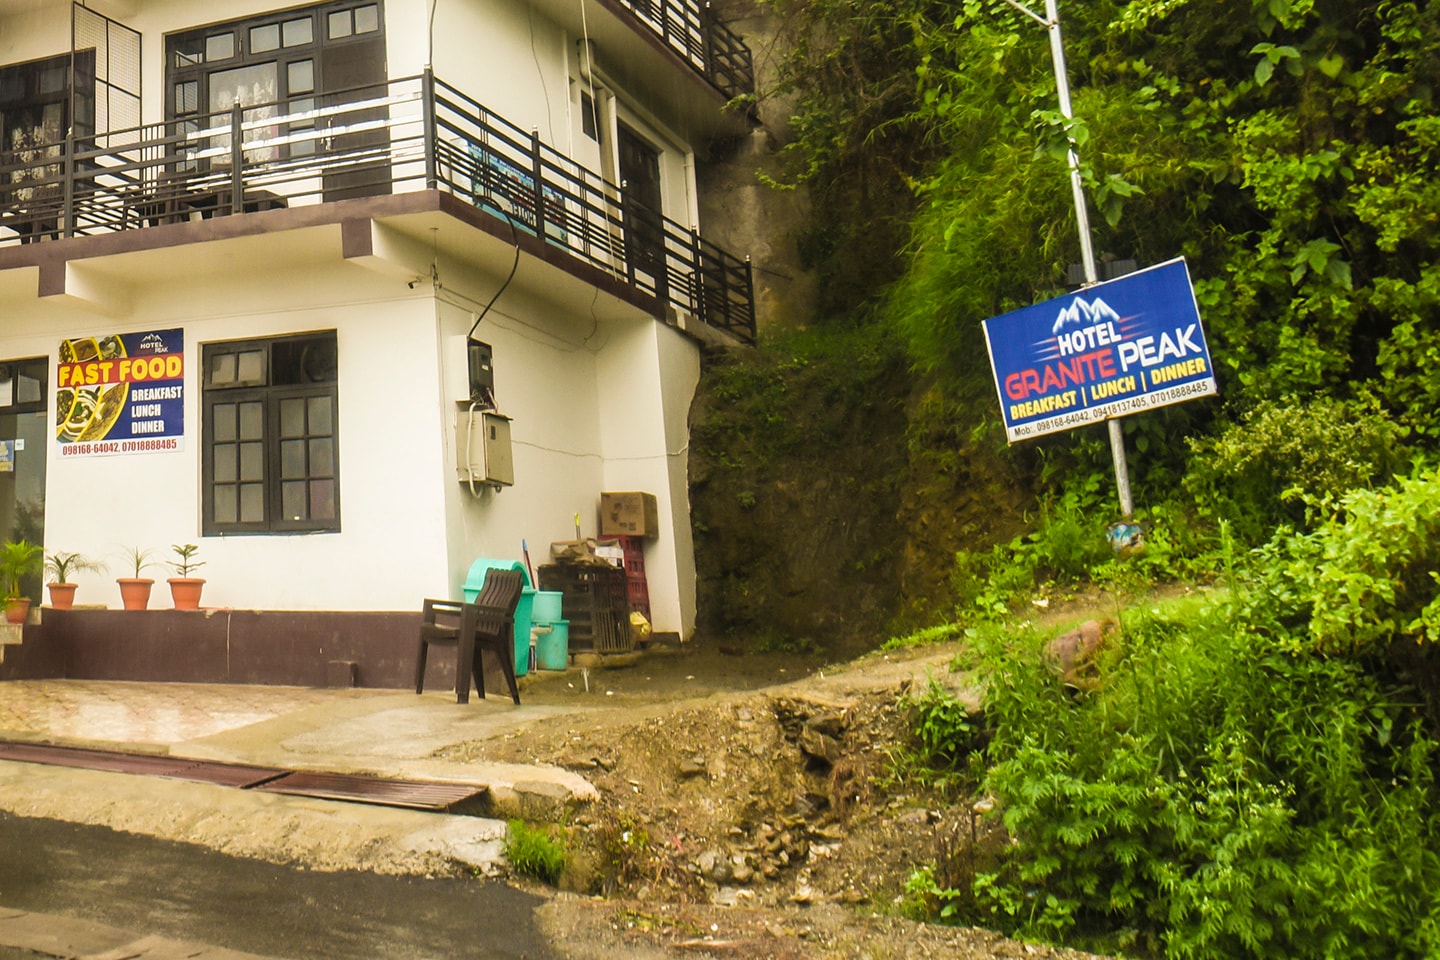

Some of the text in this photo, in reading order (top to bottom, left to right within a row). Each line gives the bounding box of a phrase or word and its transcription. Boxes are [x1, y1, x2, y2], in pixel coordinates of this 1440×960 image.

[140, 342, 163, 350] HOTEL
[1057, 321, 1122, 357] HOTEL
[58, 355, 183, 387] FAST FOOD
[1005, 324, 1202, 401] GRANITE PEAK
[131, 386, 183, 402] BREAKFAST
[1010, 357, 1207, 421] BREAKFAST LUNCH DINNER
[1150, 382, 1209, 405] 07018888485
[131, 403, 162, 418] LUNCH
[131, 419, 165, 435] DINNER
[121, 438, 178, 452] 07018888485
